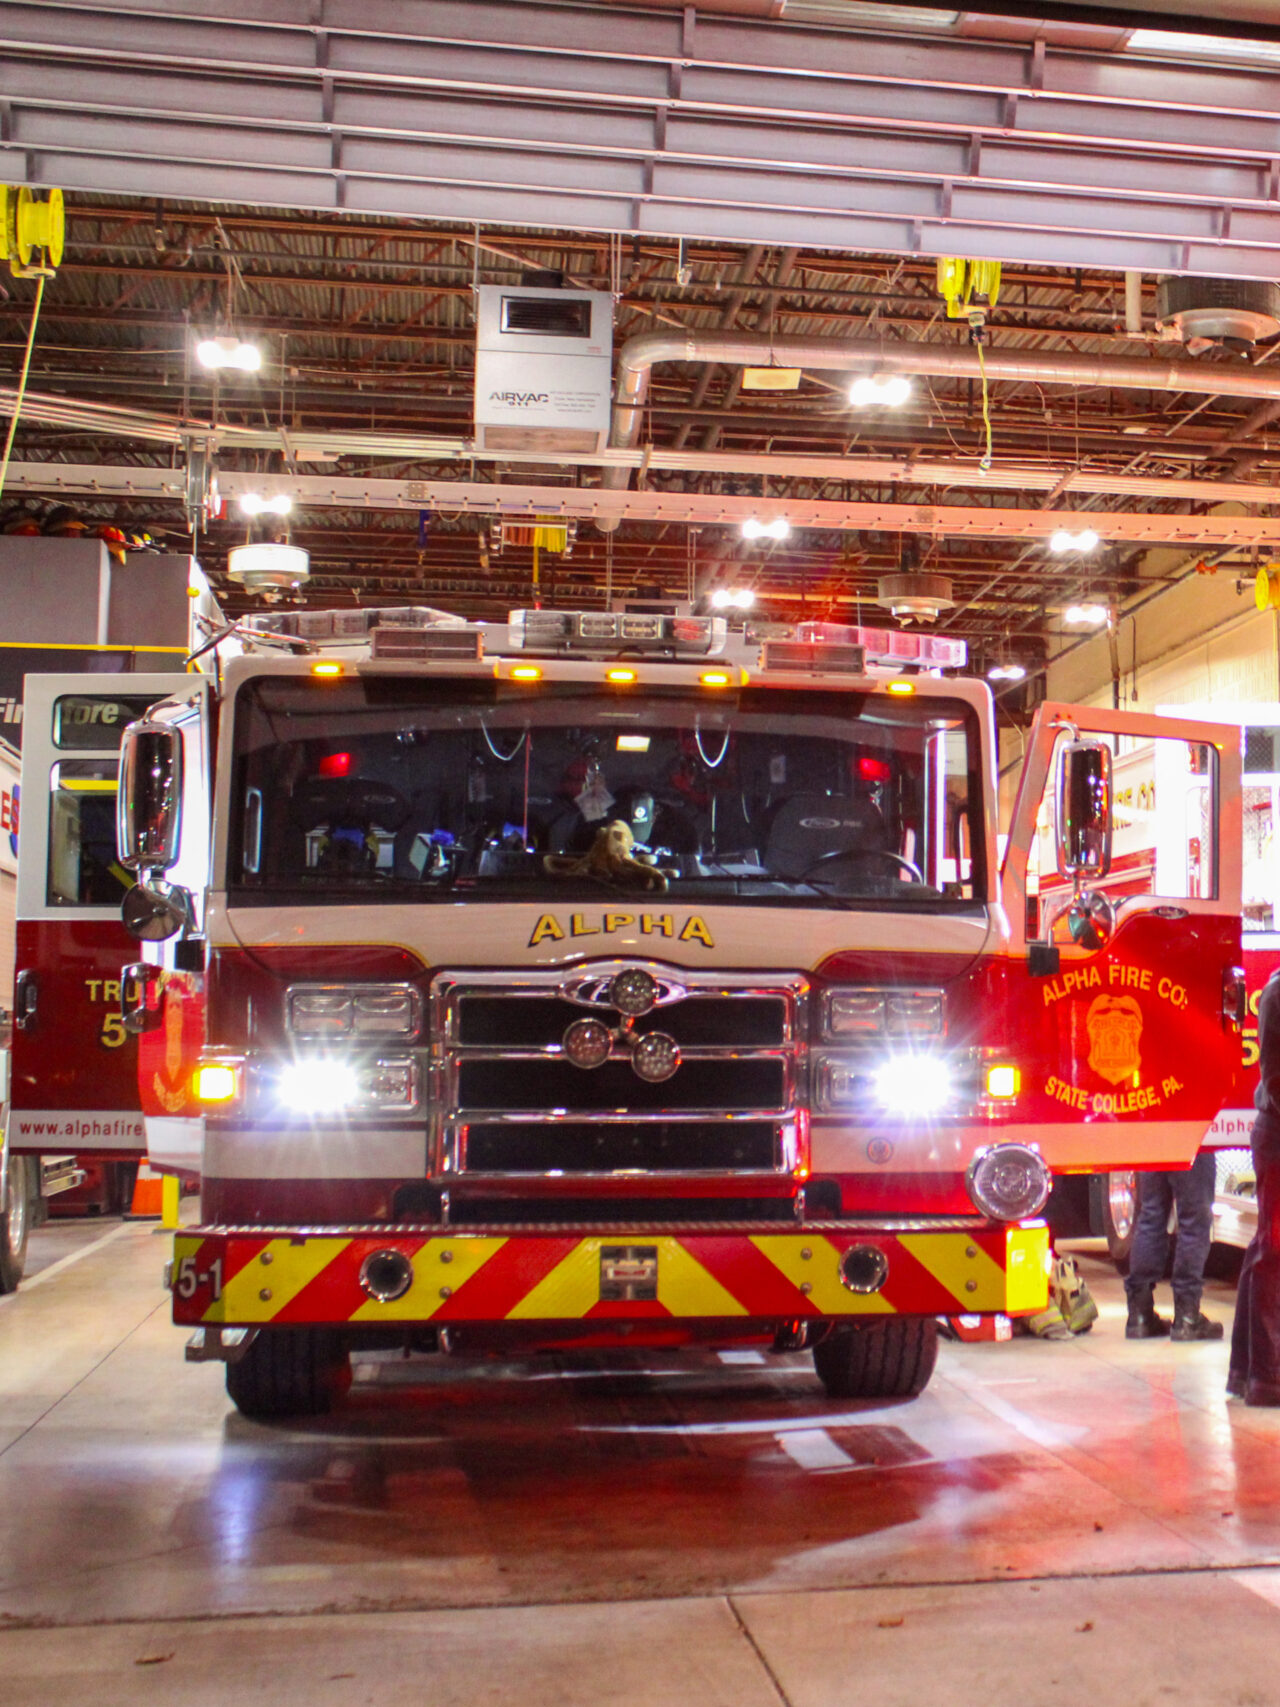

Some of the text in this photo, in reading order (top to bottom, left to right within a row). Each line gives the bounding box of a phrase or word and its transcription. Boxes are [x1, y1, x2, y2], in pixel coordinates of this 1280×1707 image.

[489, 391, 549, 403] AIRVAC
[528, 913, 715, 948] ALPHA
[85, 980, 140, 1002] TRU
[1043, 966, 1101, 1006] ALPHA
[1109, 964, 1153, 991] FIRE
[1045, 1075, 1184, 1114] STATE COLLEGE, PA.
[19, 1119, 144, 1138] www.alphafire
[1211, 1118, 1254, 1137] alpha
[178, 1255, 222, 1299] 5-1
